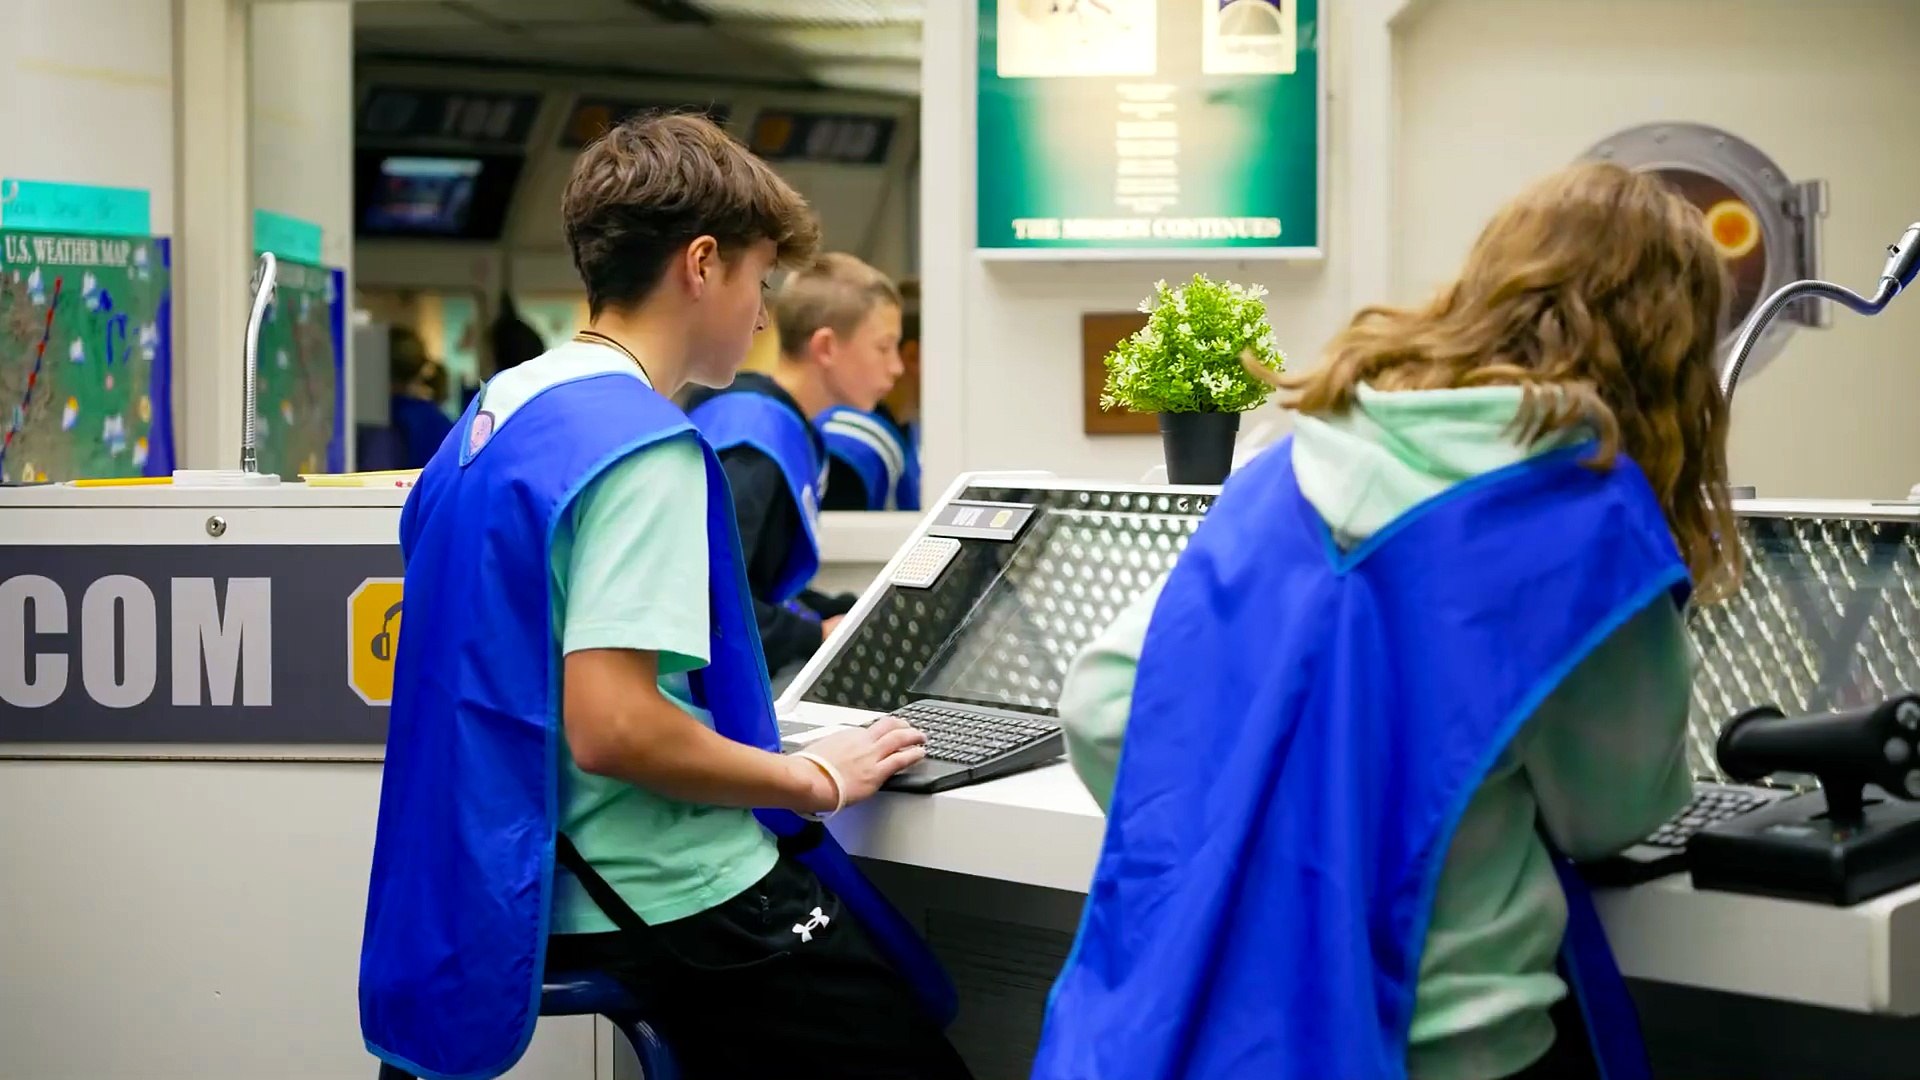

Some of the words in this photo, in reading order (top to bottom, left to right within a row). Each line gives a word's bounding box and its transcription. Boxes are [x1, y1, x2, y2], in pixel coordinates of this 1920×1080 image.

[5, 235, 31, 264] U.S.
[33, 236, 99, 265] WEATHER
[101, 239, 130, 267] MAP
[0, 574, 272, 708] COM
